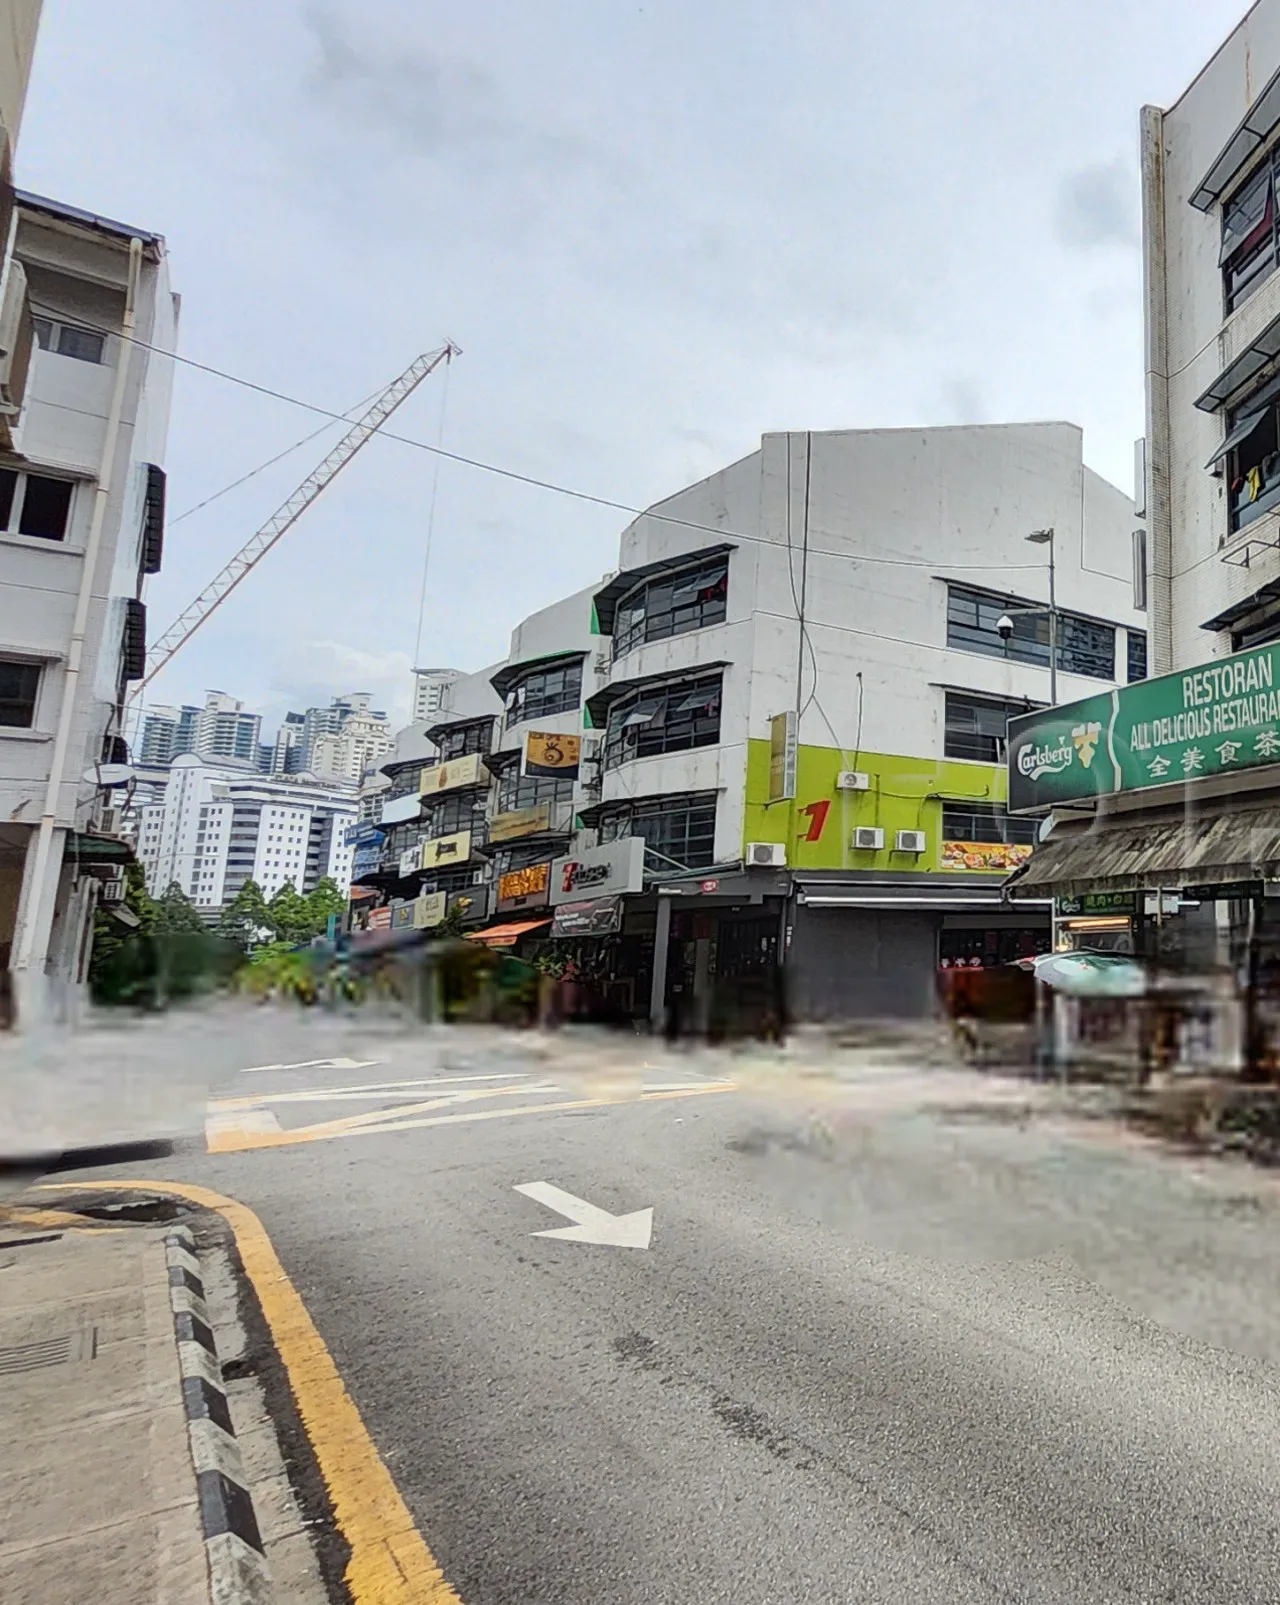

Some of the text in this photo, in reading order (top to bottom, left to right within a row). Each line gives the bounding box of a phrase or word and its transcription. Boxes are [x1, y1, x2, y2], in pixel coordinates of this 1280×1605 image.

[1182, 654, 1273, 708] RESTORAN
[1131, 724, 1151, 752] ALL
[1153, 707, 1212, 747] DELICIOUS
[1017, 735, 1074, 781] Carlsberg
